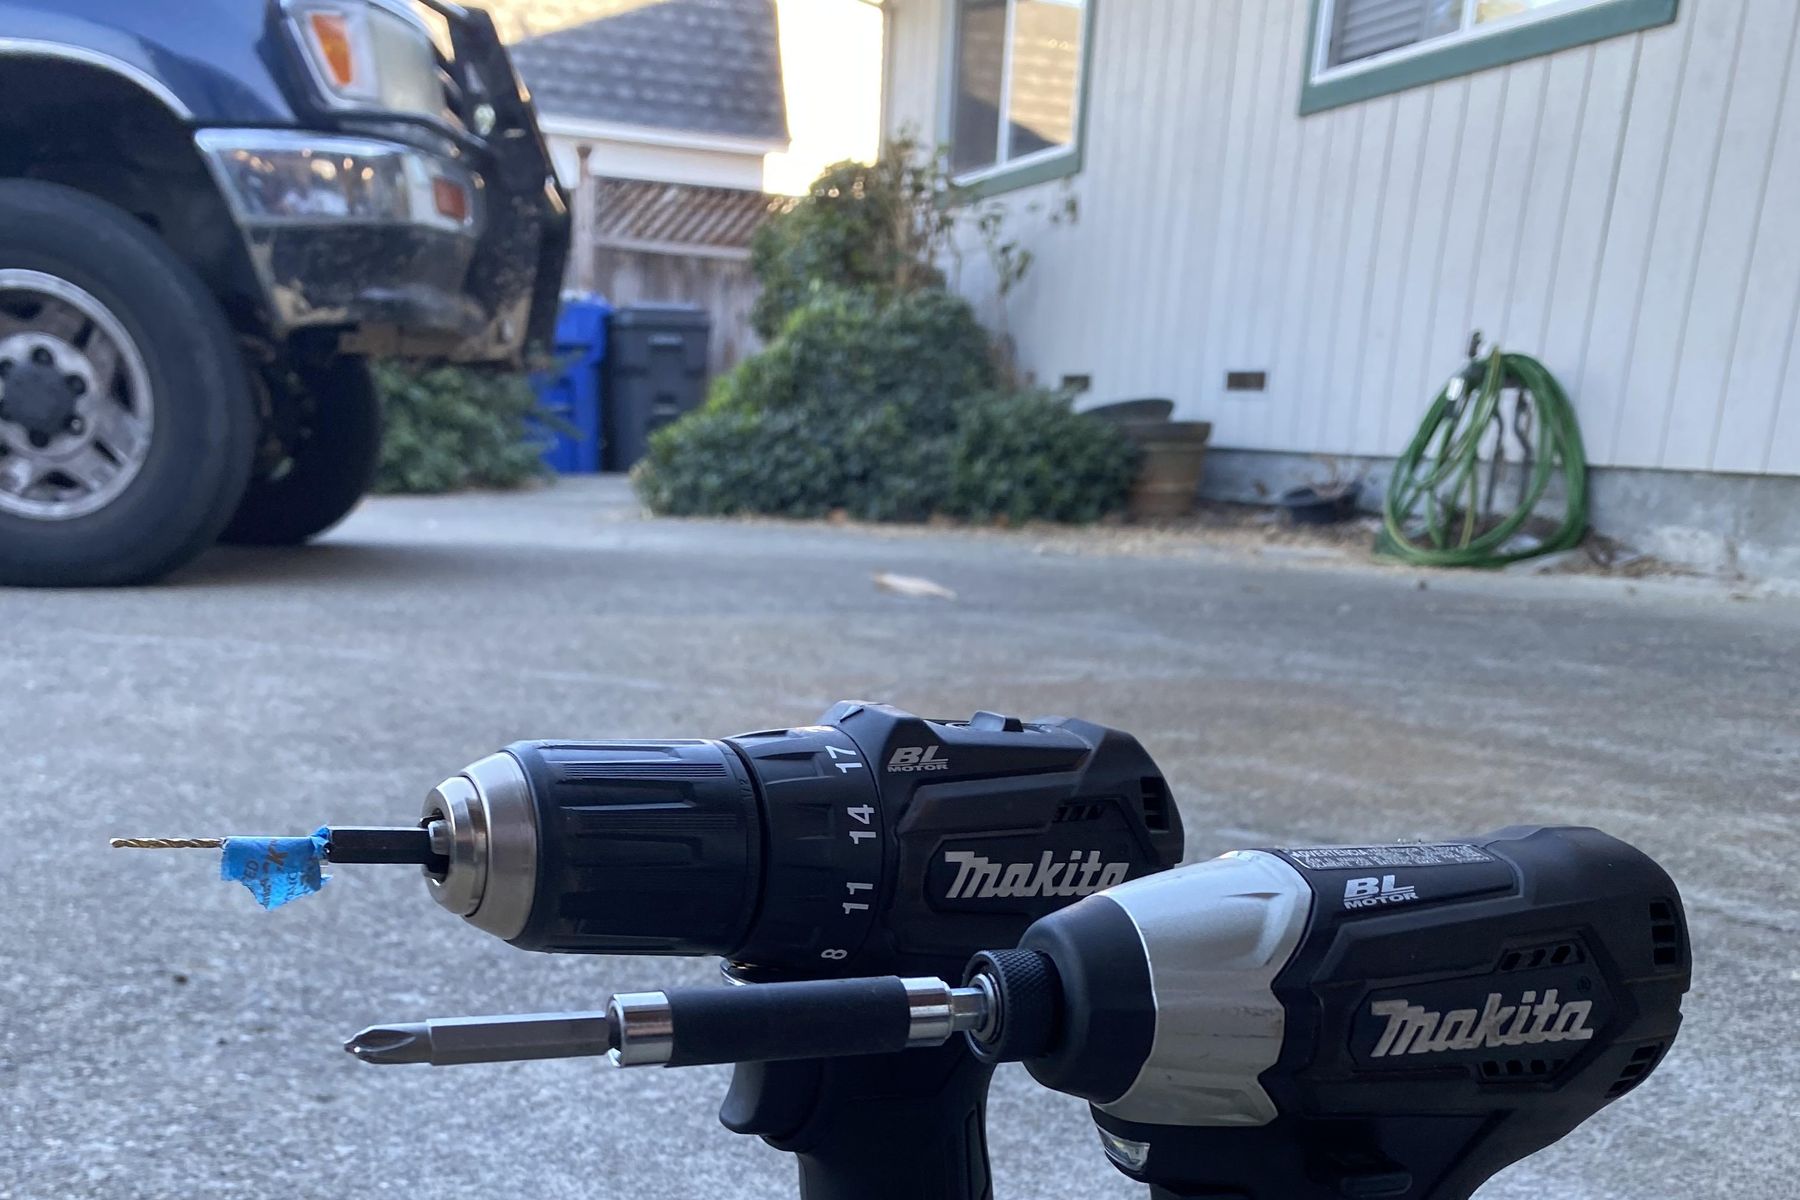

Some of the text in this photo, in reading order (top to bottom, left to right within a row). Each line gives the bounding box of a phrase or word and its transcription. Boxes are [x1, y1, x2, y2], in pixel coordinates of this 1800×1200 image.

[824, 745, 863, 774] 17
[889, 745, 949, 765] BL
[887, 763, 949, 773] MOTOR
[846, 804, 877, 844] 14
[1343, 874, 1415, 898] BL
[841, 882, 874, 915] 11
[1343, 892, 1420, 910] MOTOR
[820, 948, 848, 960] 8
